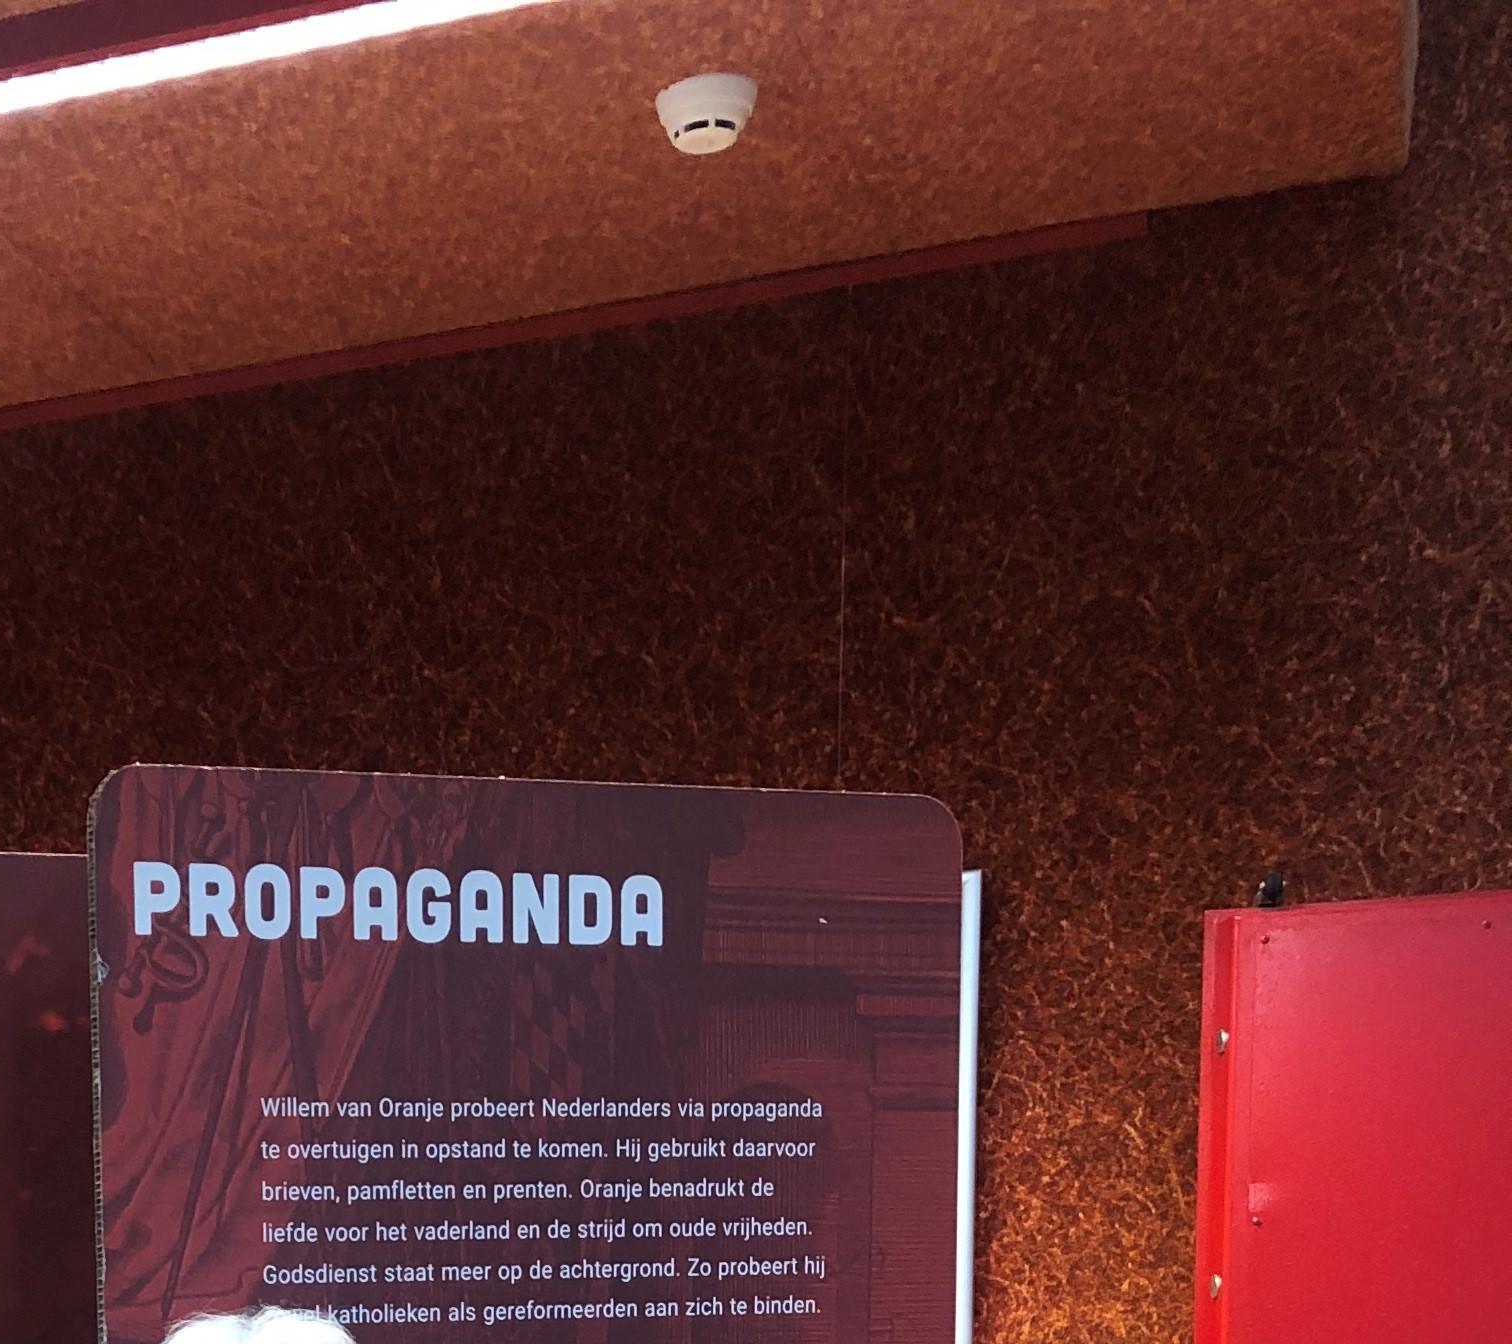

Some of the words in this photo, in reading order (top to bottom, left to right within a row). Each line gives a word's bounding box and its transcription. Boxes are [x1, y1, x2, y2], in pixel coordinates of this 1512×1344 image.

[134, 862, 663, 946] PROPAGANDA
[261, 1096, 330, 1118] Willem
[337, 1103, 371, 1118] van
[379, 1097, 443, 1122] Oranje
[451, 1097, 535, 1122] probeert
[542, 1097, 671, 1118] Nederlanders
[678, 1098, 704, 1117] via
[712, 1098, 822, 1122] propaganda
[260, 1141, 280, 1159] te
[288, 1139, 393, 1164] overtuigen
[402, 1139, 418, 1158] in
[426, 1138, 505, 1163] opstand
[512, 1140, 531, 1158] te
[539, 1138, 608, 1158] komen.
[617, 1138, 640, 1162] Hij
[648, 1138, 726, 1162] gebruikt
[733, 1138, 816, 1157] daarvoor
[262, 1181, 340, 1203] brieven,
[348, 1179, 455, 1205] pamfletten
[463, 1184, 486, 1200] en
[494, 1181, 572, 1204] prenten.
[581, 1179, 642, 1202] Oranje
[650, 1177, 744, 1200] benadrukt
[752, 1177, 774, 1196] de
[263, 1222, 318, 1243] liefde
[325, 1227, 369, 1242] voor
[376, 1221, 407, 1241] het
[414, 1220, 510, 1241] vaderland
[517, 1224, 540, 1240] en
[548, 1219, 570, 1239] de
[578, 1218, 625, 1243] strijd
[633, 1223, 662, 1238] om
[670, 1218, 716, 1238] oude
[722, 1217, 812, 1241] vrijheden.
[263, 1263, 377, 1284] Godsdienst
[385, 1264, 434, 1283] staat
[442, 1265, 492, 1281] meer
[498, 1265, 522, 1285] op
[529, 1259, 552, 1280] de
[560, 1257, 680, 1282] achtergrond.
[688, 1258, 711, 1277] Zo
[718, 1256, 798, 1280] probeert
[805, 1256, 825, 1279] hij
[328, 1303, 440, 1324] katholieken
[448, 1302, 476, 1321] als
[483, 1298, 637, 1325] gereformeerden
[645, 1302, 678, 1318] aan
[685, 1297, 723, 1317] zich
[729, 1298, 747, 1316] te
[754, 1295, 820, 1315] binden.
